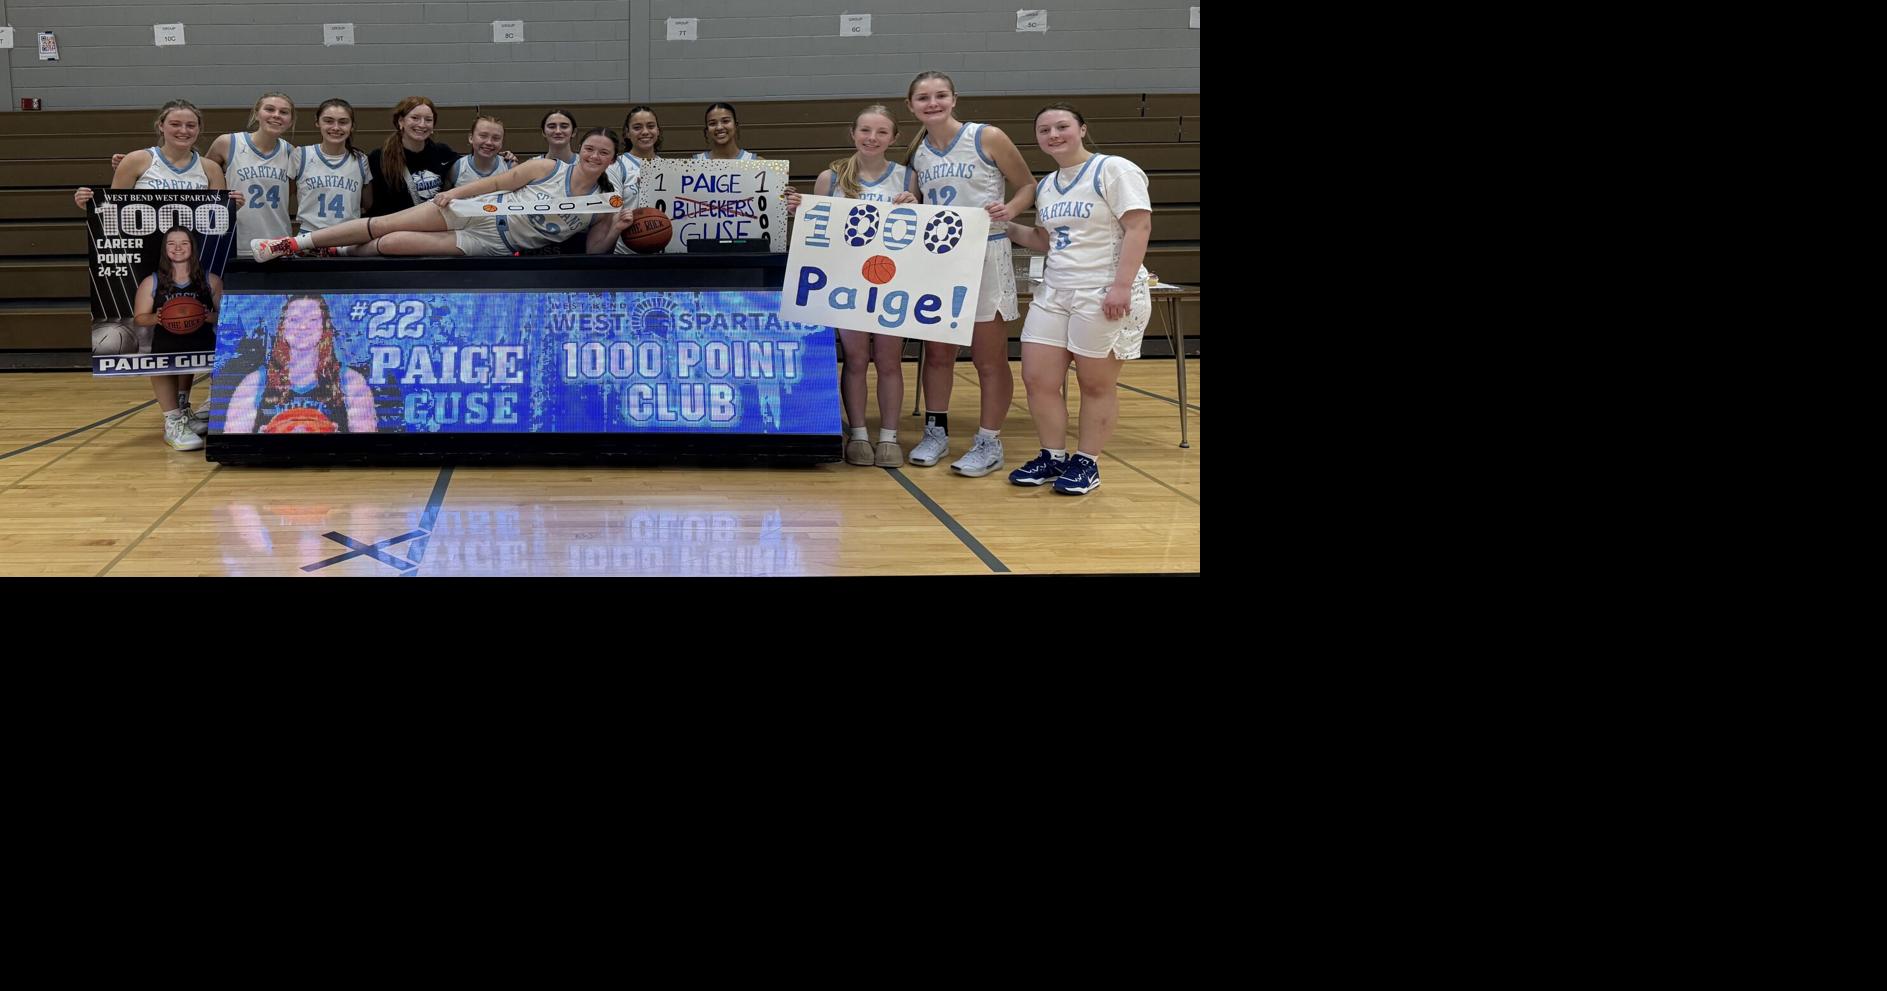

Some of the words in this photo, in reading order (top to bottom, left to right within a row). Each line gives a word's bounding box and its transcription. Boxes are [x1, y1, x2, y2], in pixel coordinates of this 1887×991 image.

[237, 165, 288, 183] SPARTANS
[305, 175, 359, 193] SPARTANS
[681, 172, 742, 194] PAIGE
[919, 162, 976, 185] PARTANS
[104, 194, 128, 202] WEST
[130, 194, 153, 202] BEND
[155, 194, 178, 202] WEST
[180, 194, 221, 202] SPARTANS
[248, 184, 280, 209] 24
[317, 193, 345, 218] 14
[928, 185, 957, 206] 12
[94, 202, 230, 236] 1000
[1040, 201, 1094, 221] PARTANS
[804, 202, 964, 255] 1000
[1054, 226, 1072, 251] 5
[97, 238, 143, 249] CAREER
[98, 253, 141, 264] POINTS
[98, 266, 128, 277] 24-25
[795, 265, 968, 329] Paige!
[351, 300, 425, 339] #22
[552, 313, 625, 331] WEST
[100, 356, 169, 371] PAIGE
[175, 354, 216, 367] GUS
[369, 346, 524, 384] PAIGE
[563, 342, 663, 379] 1000
[677, 341, 800, 378] POINT
[404, 392, 518, 425] GUSE
[627, 384, 737, 421] CLUB
